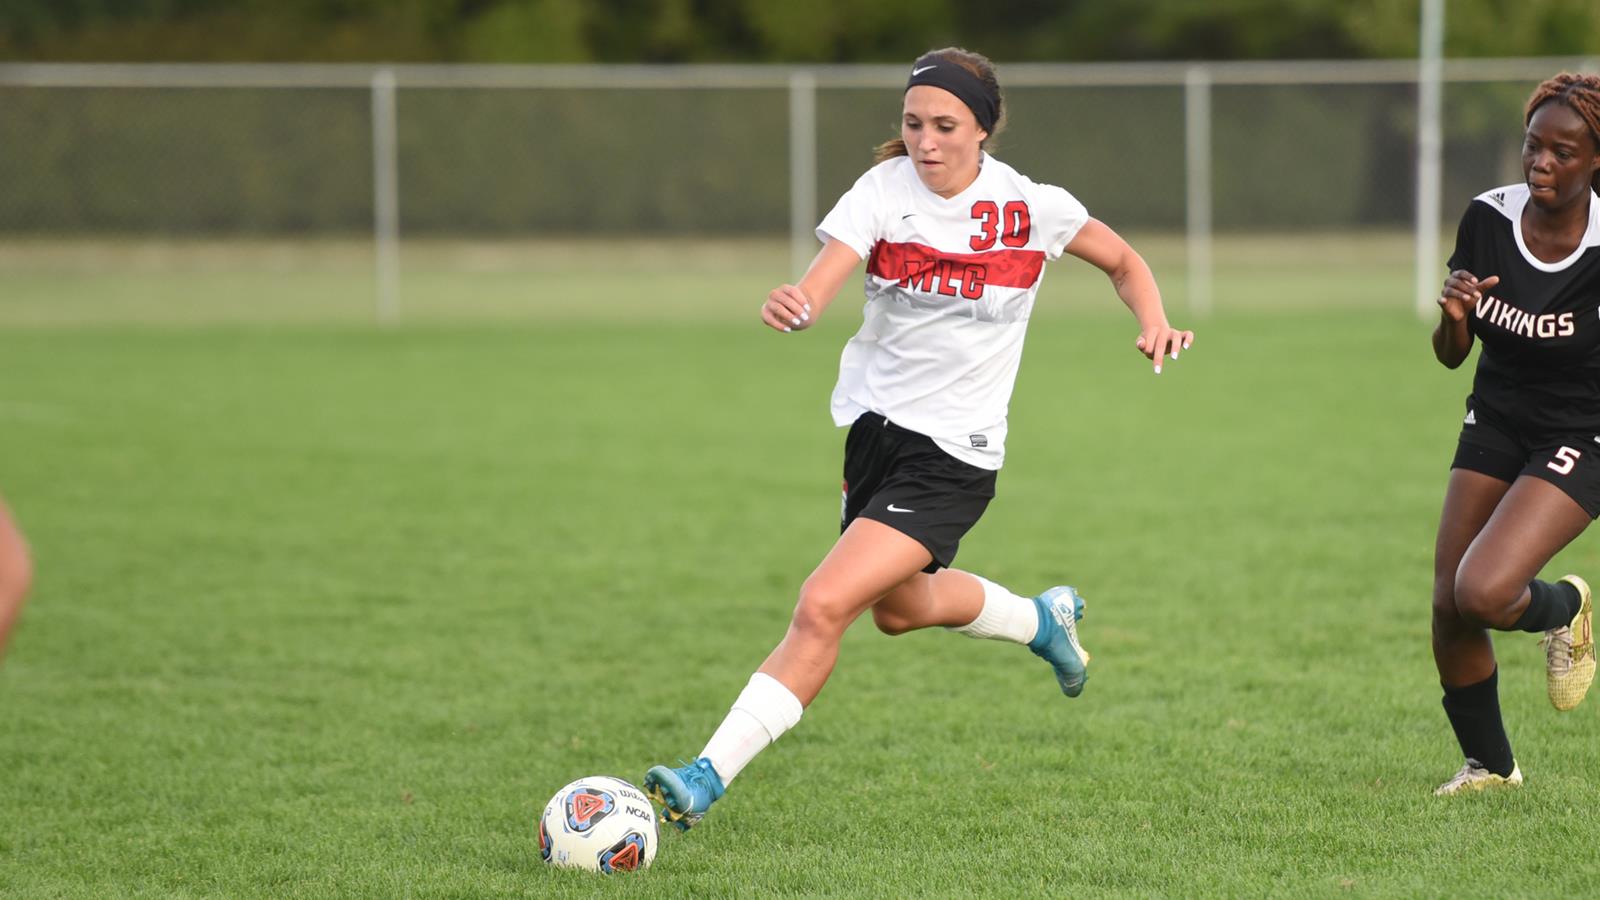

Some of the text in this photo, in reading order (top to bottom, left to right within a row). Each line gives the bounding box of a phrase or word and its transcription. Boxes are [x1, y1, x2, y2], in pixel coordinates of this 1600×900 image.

[969, 200, 1031, 251] 30
[898, 259, 987, 300] MLC
[1475, 295, 1575, 338] VIKINGS
[1546, 445, 1581, 475] 5
[625, 805, 651, 823] NCAA
